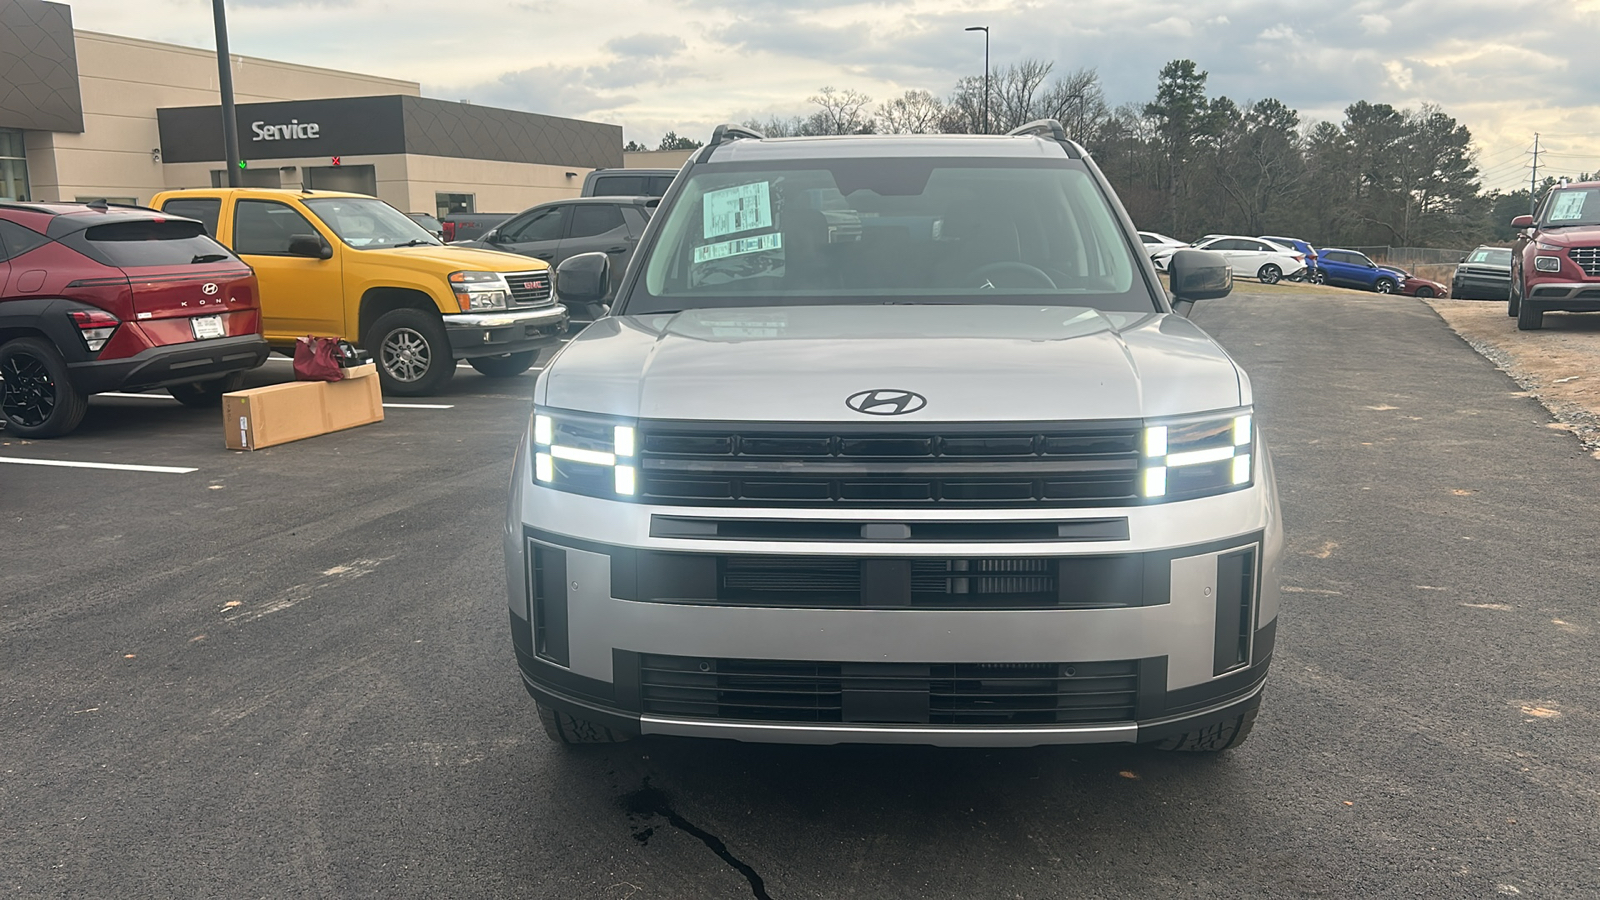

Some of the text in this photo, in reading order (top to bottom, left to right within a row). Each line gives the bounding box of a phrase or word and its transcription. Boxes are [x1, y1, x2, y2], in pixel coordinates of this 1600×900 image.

[252, 119, 320, 141] Service
[523, 281, 542, 289] GMC
[181, 297, 236, 306] KONA
